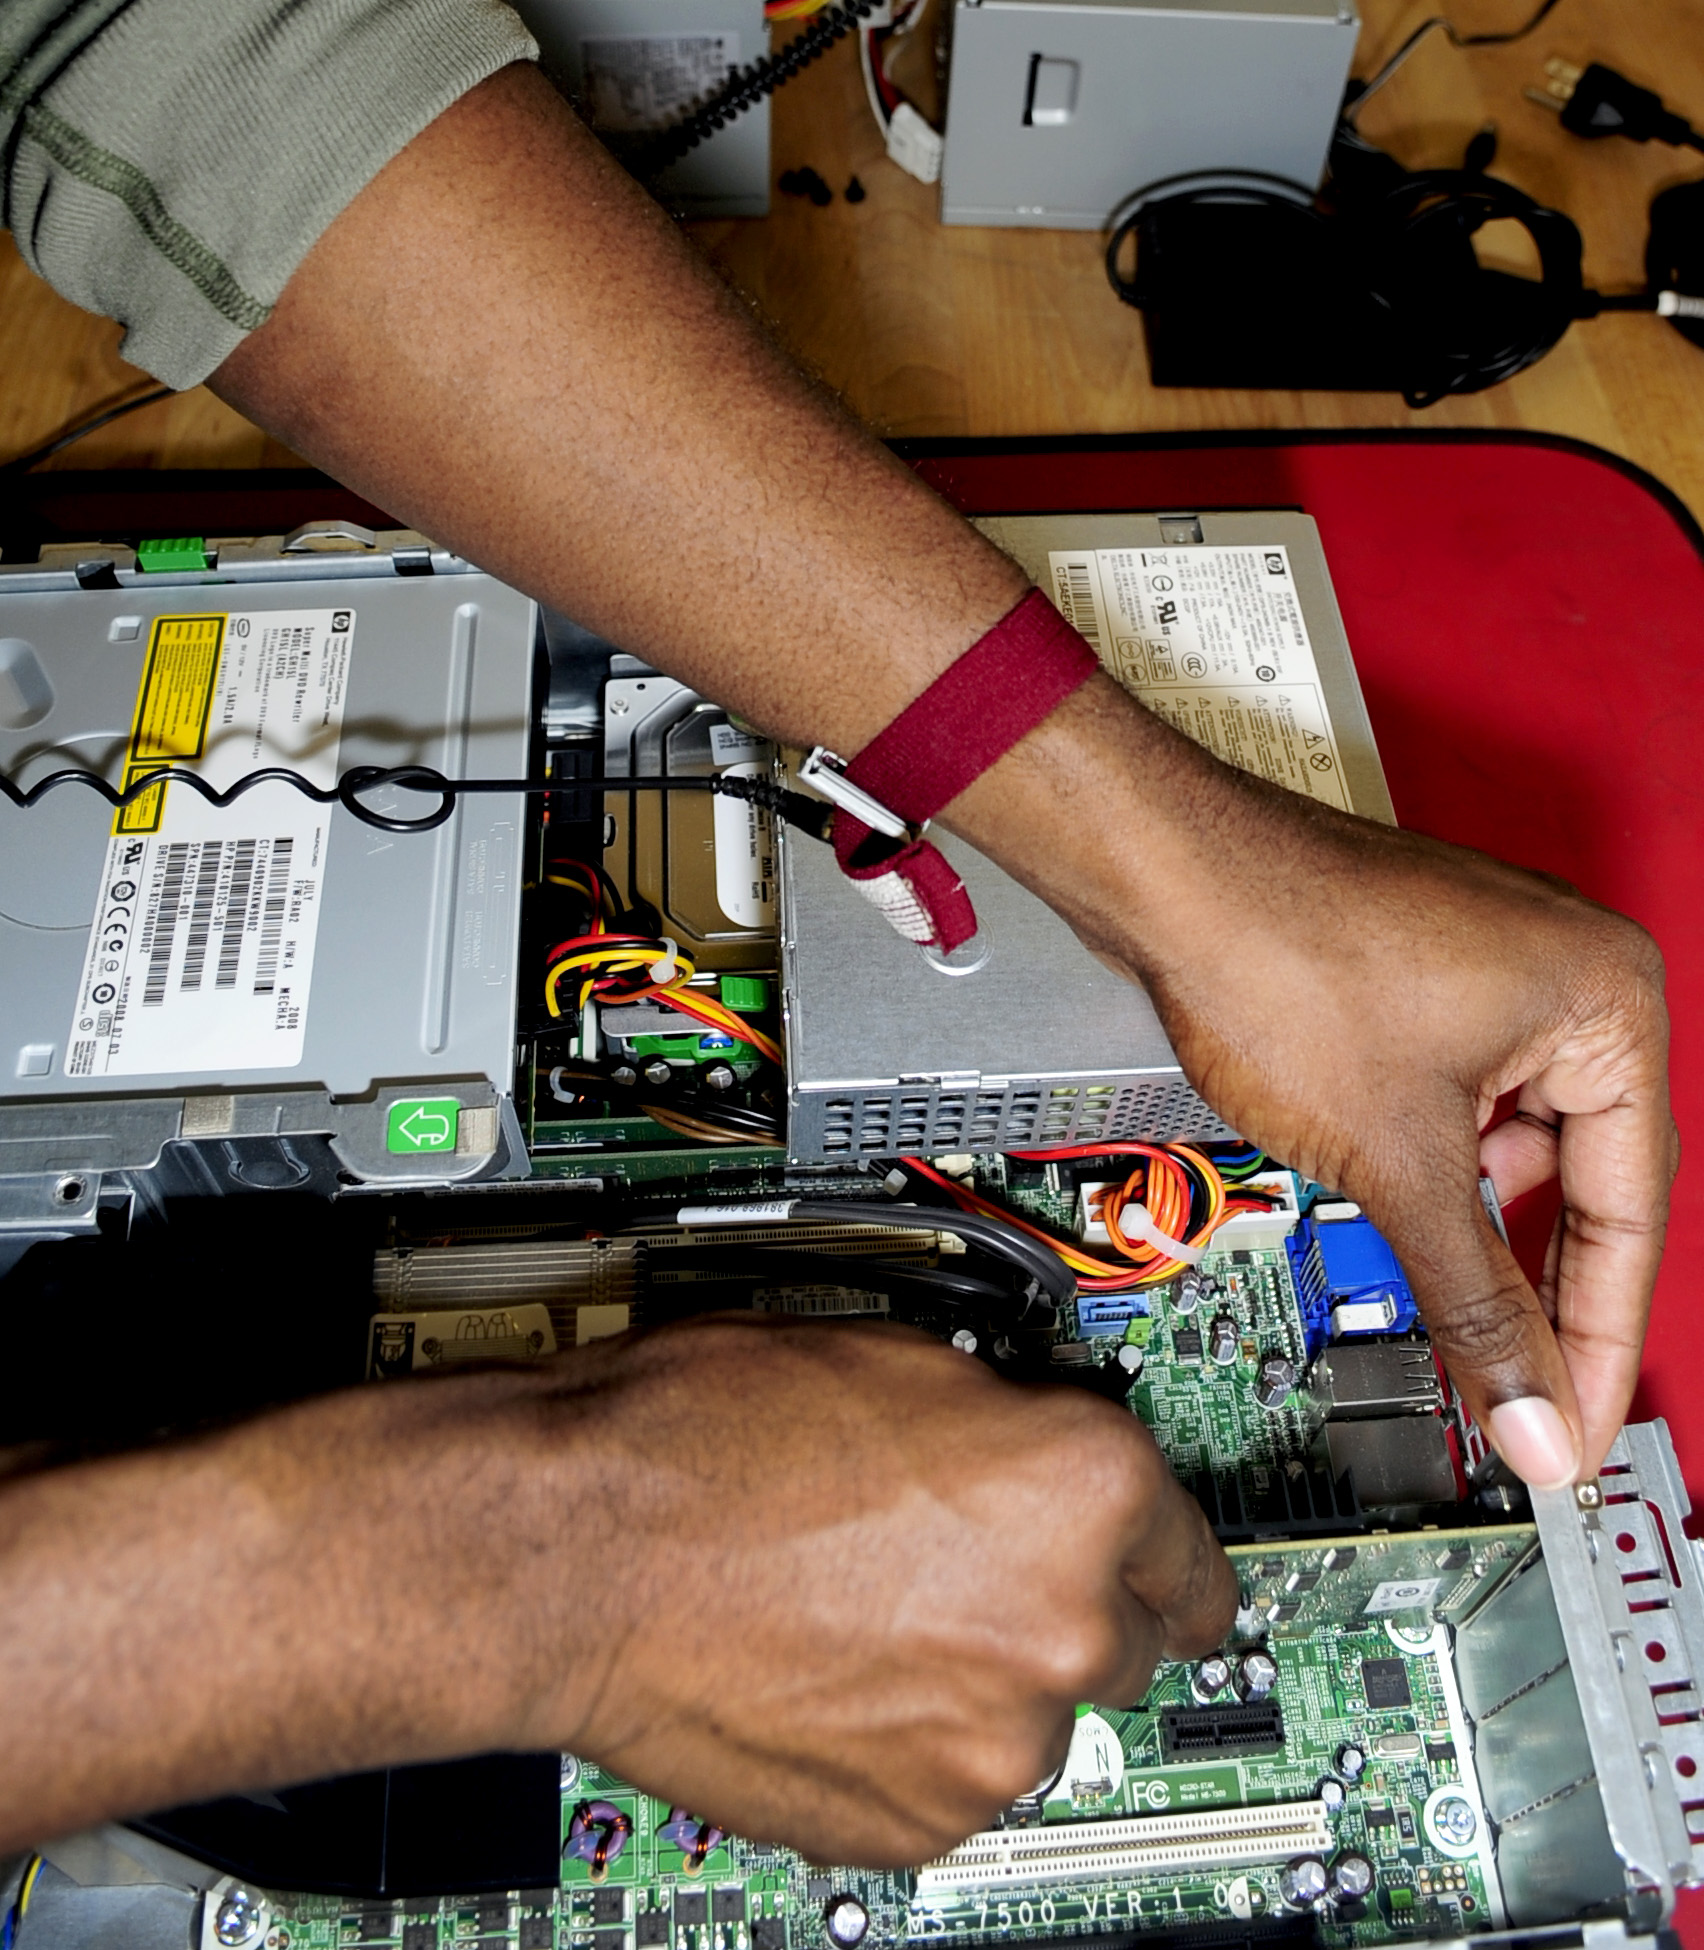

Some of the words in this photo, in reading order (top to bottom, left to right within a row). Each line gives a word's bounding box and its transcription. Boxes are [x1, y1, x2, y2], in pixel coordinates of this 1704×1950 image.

[301, 626, 314, 647] Super
[299, 651, 310, 669] Multi
[296, 672, 307, 687] DVD
[291, 689, 305, 722] Rewriter
[153, 844, 168, 869] DRIVE
[224, 841, 235, 852] HP
[177, 842, 200, 920] SPN:447310-001
[302, 880, 315, 900] JULY
[282, 940, 296, 968] H/W:A
[274, 987, 290, 1030] MECHA:A
[286, 1006, 299, 1029] 2008
[907, 1898, 1056, 1936] MS-7500
